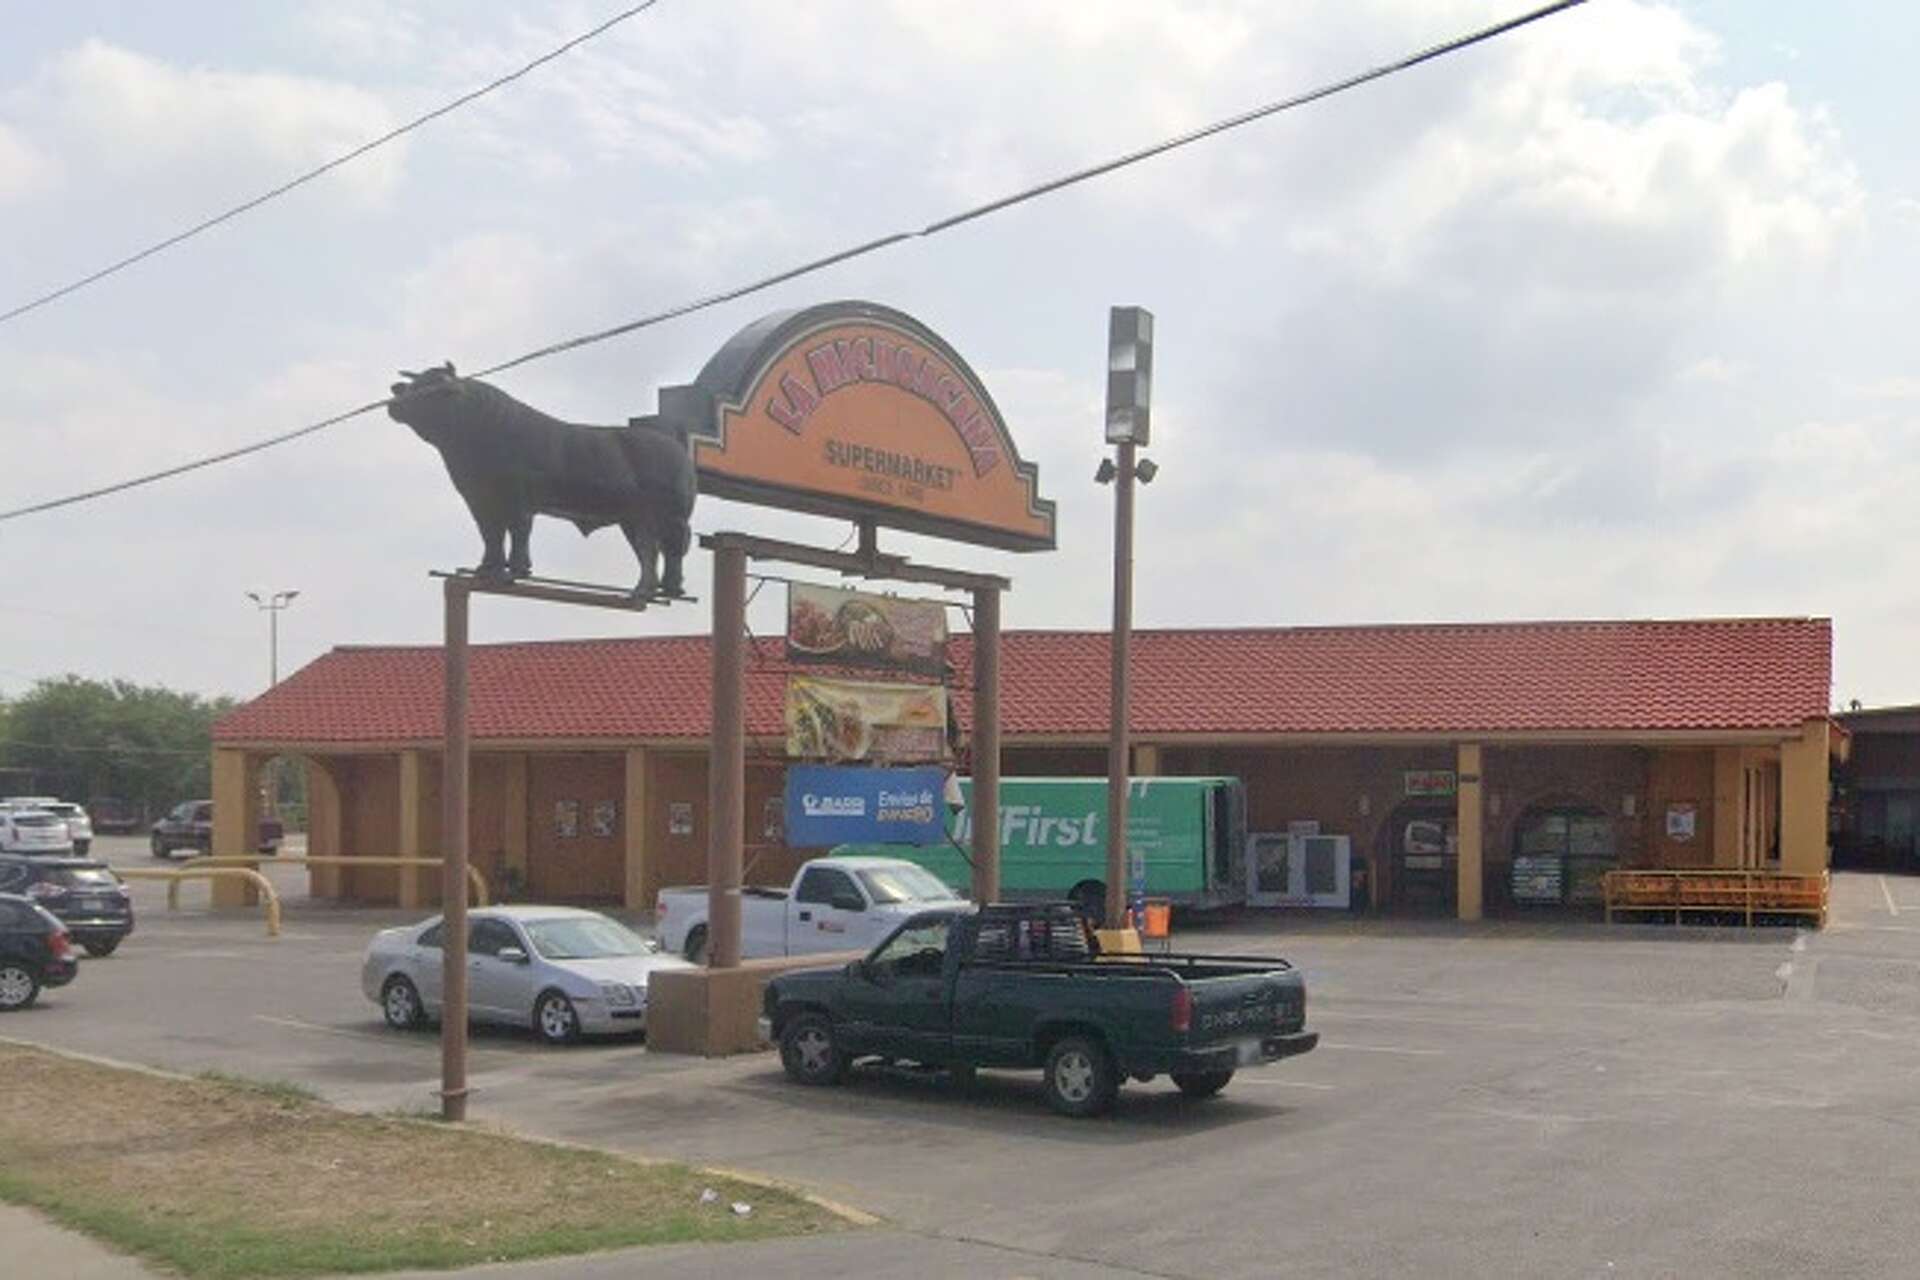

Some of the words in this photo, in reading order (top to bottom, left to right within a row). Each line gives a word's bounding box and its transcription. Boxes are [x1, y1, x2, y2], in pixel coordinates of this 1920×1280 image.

[765, 372, 824, 435] LA
[805, 335, 1001, 479] MICHOACANA
[823, 439, 955, 488] SUPERMARKET
